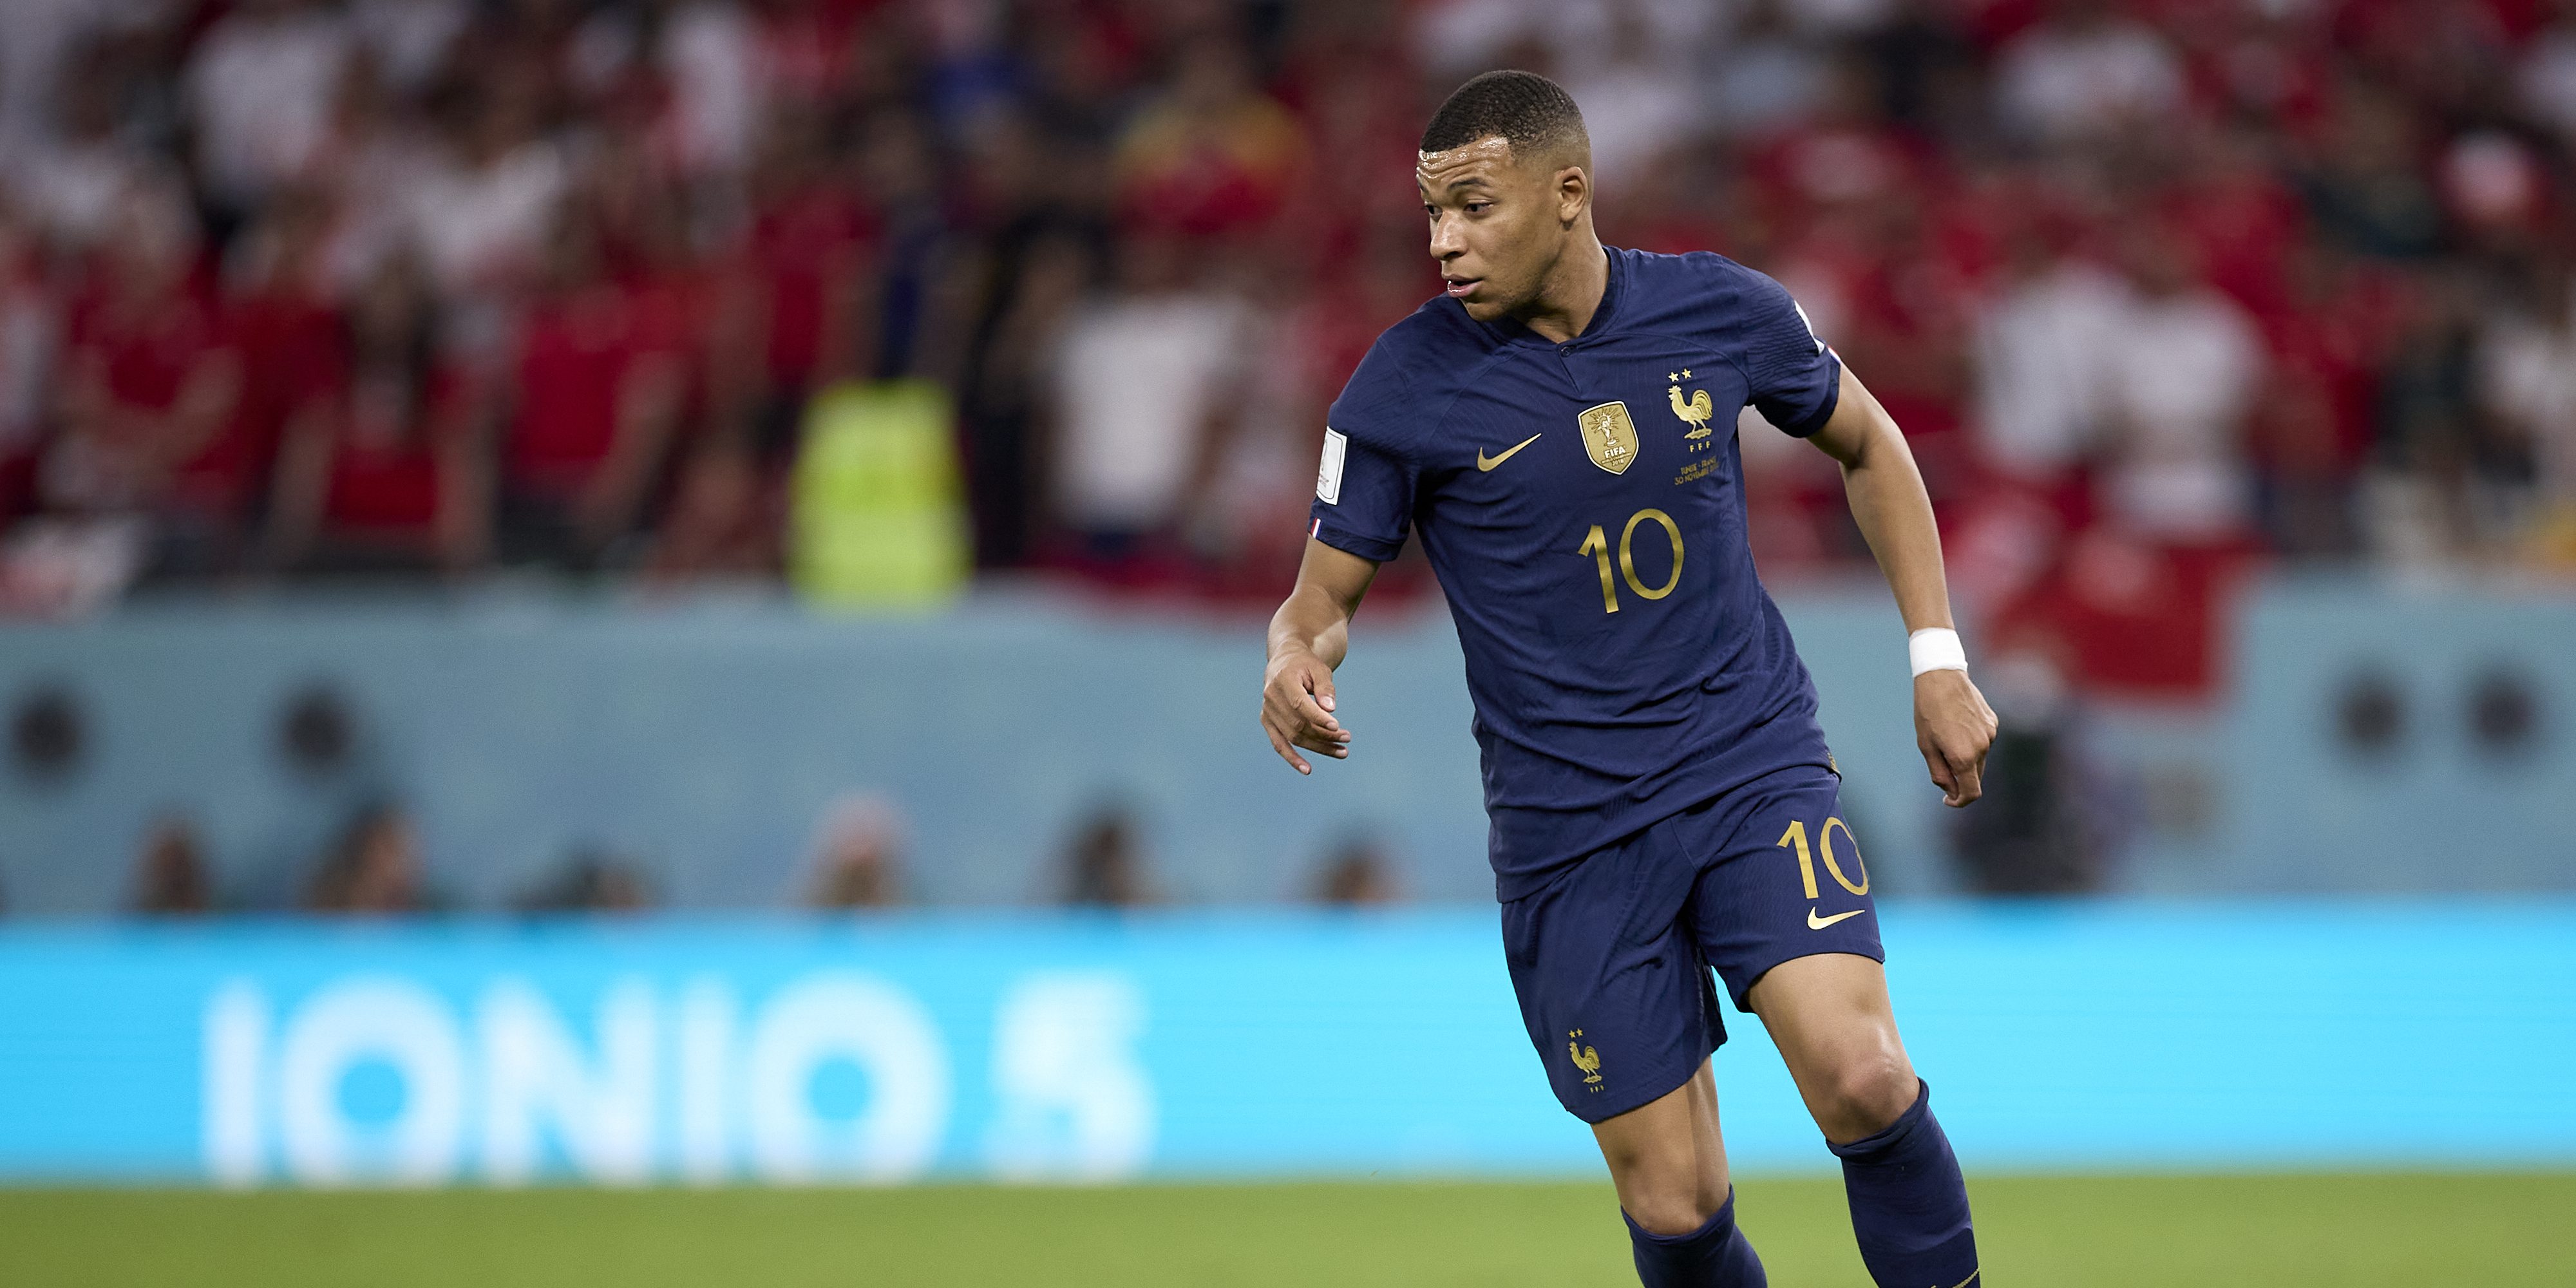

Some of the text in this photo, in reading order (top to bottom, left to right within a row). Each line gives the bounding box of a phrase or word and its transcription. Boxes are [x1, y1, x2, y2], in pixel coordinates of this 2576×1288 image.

[1604, 446, 1626, 459] FIFA
[1578, 508, 1684, 614] 10
[1777, 817, 1869, 900] 10
[989, 969, 1158, 1184] 5
